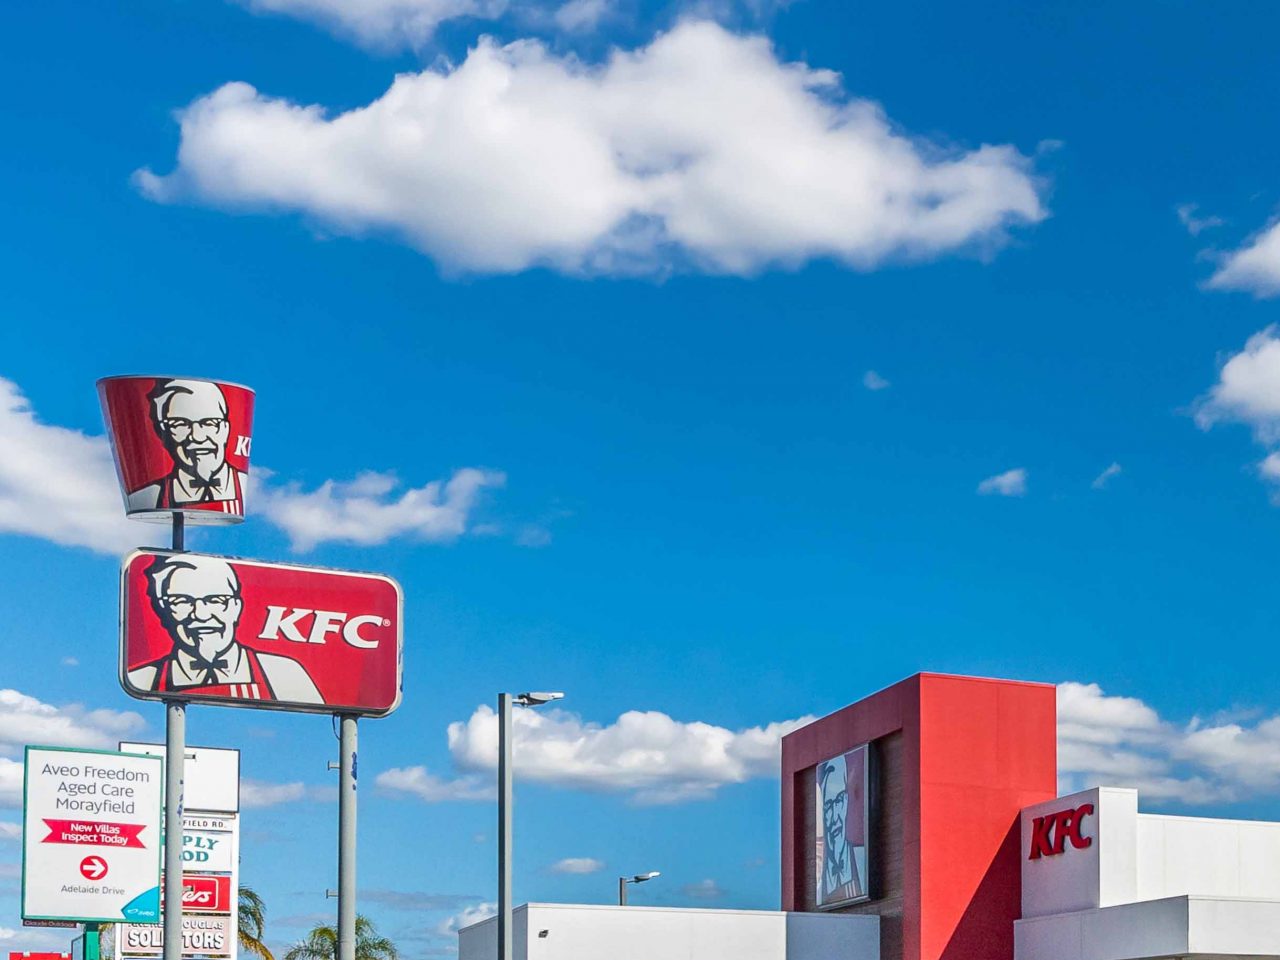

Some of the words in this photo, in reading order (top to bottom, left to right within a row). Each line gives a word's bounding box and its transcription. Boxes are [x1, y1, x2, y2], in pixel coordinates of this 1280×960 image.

[258, 605, 384, 649] KFC
[42, 764, 80, 776] Aveo
[84, 766, 150, 782] Freedom
[58, 782, 96, 796] Aged
[102, 784, 134, 798] Care
[56, 798, 135, 814] Morayfield
[70, 824, 92, 832] New
[95, 825, 120, 834] Villas
[1029, 804, 1094, 860] KFC
[62, 832, 98, 842] Inspect
[100, 834, 128, 846] Today
[183, 836, 220, 850] PLY
[61, 885, 99, 894] Adelaide
[102, 886, 125, 895] Drive
[183, 920, 224, 930] OUGLAS
